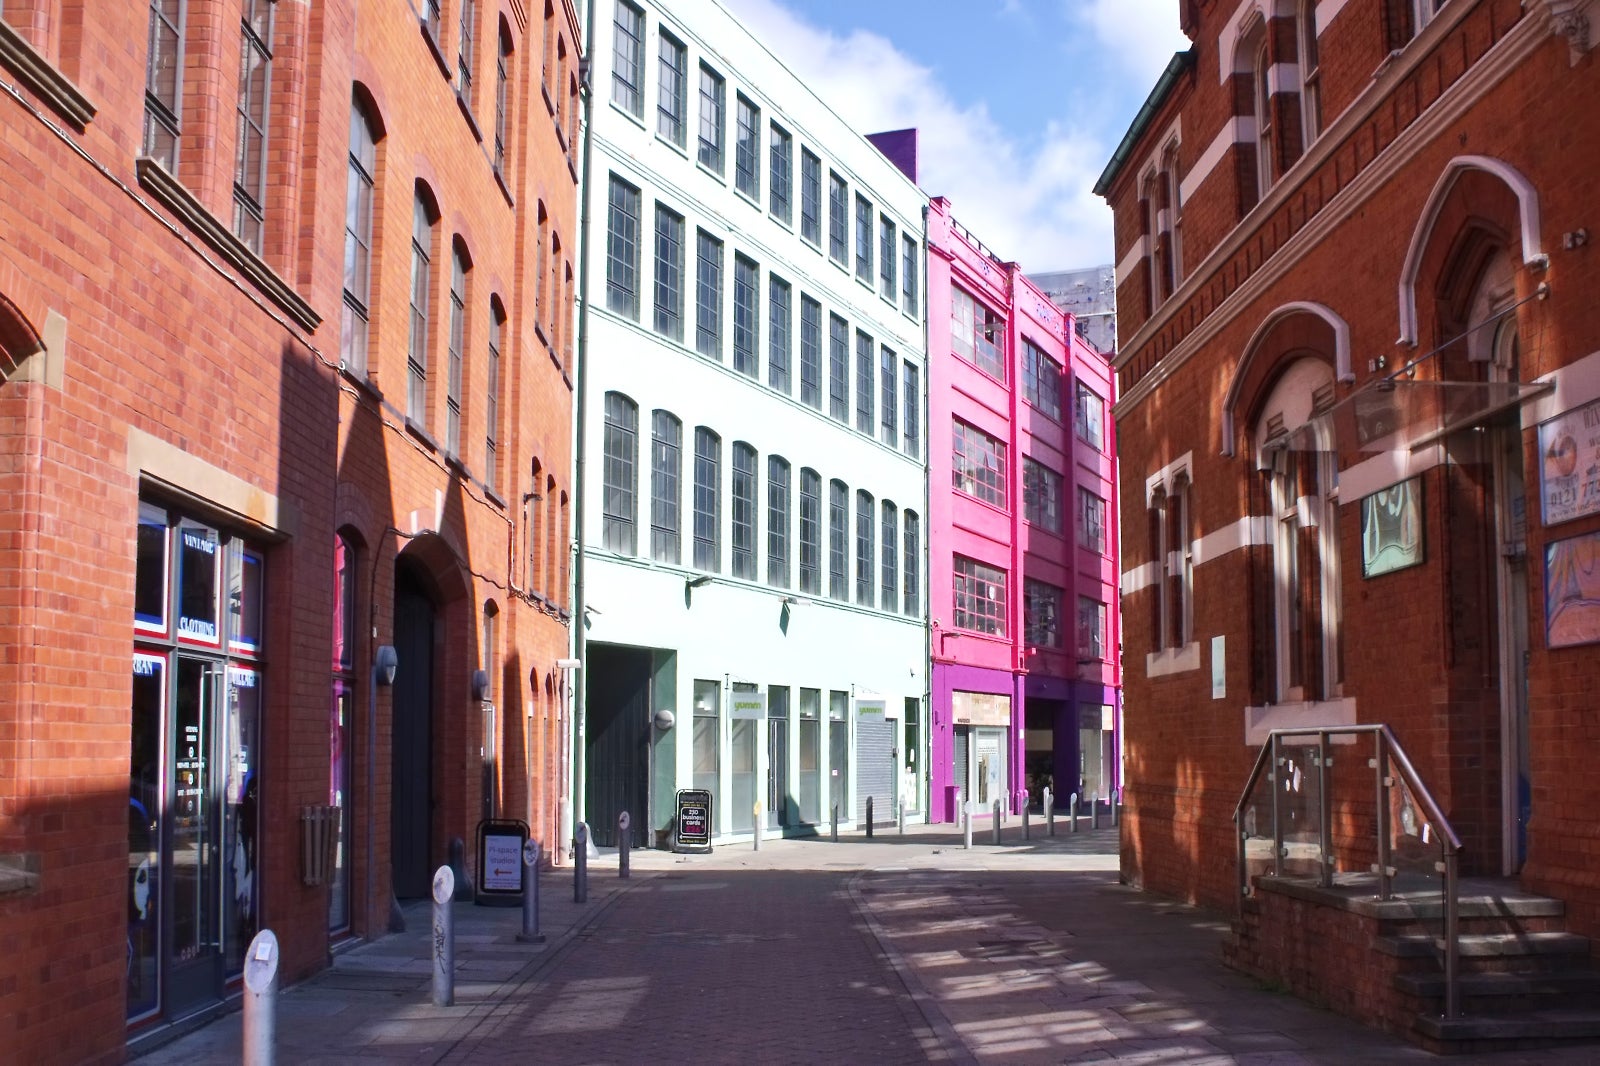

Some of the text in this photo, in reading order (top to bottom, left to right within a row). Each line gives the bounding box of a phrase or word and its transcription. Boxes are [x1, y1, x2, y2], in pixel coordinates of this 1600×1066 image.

[184, 533, 214, 554] VINTAGE
[180, 617, 214, 637] CLOTHING
[734, 701, 761, 711] yumm
[859, 706, 882, 715] yumm
[490, 857, 517, 865] studios
